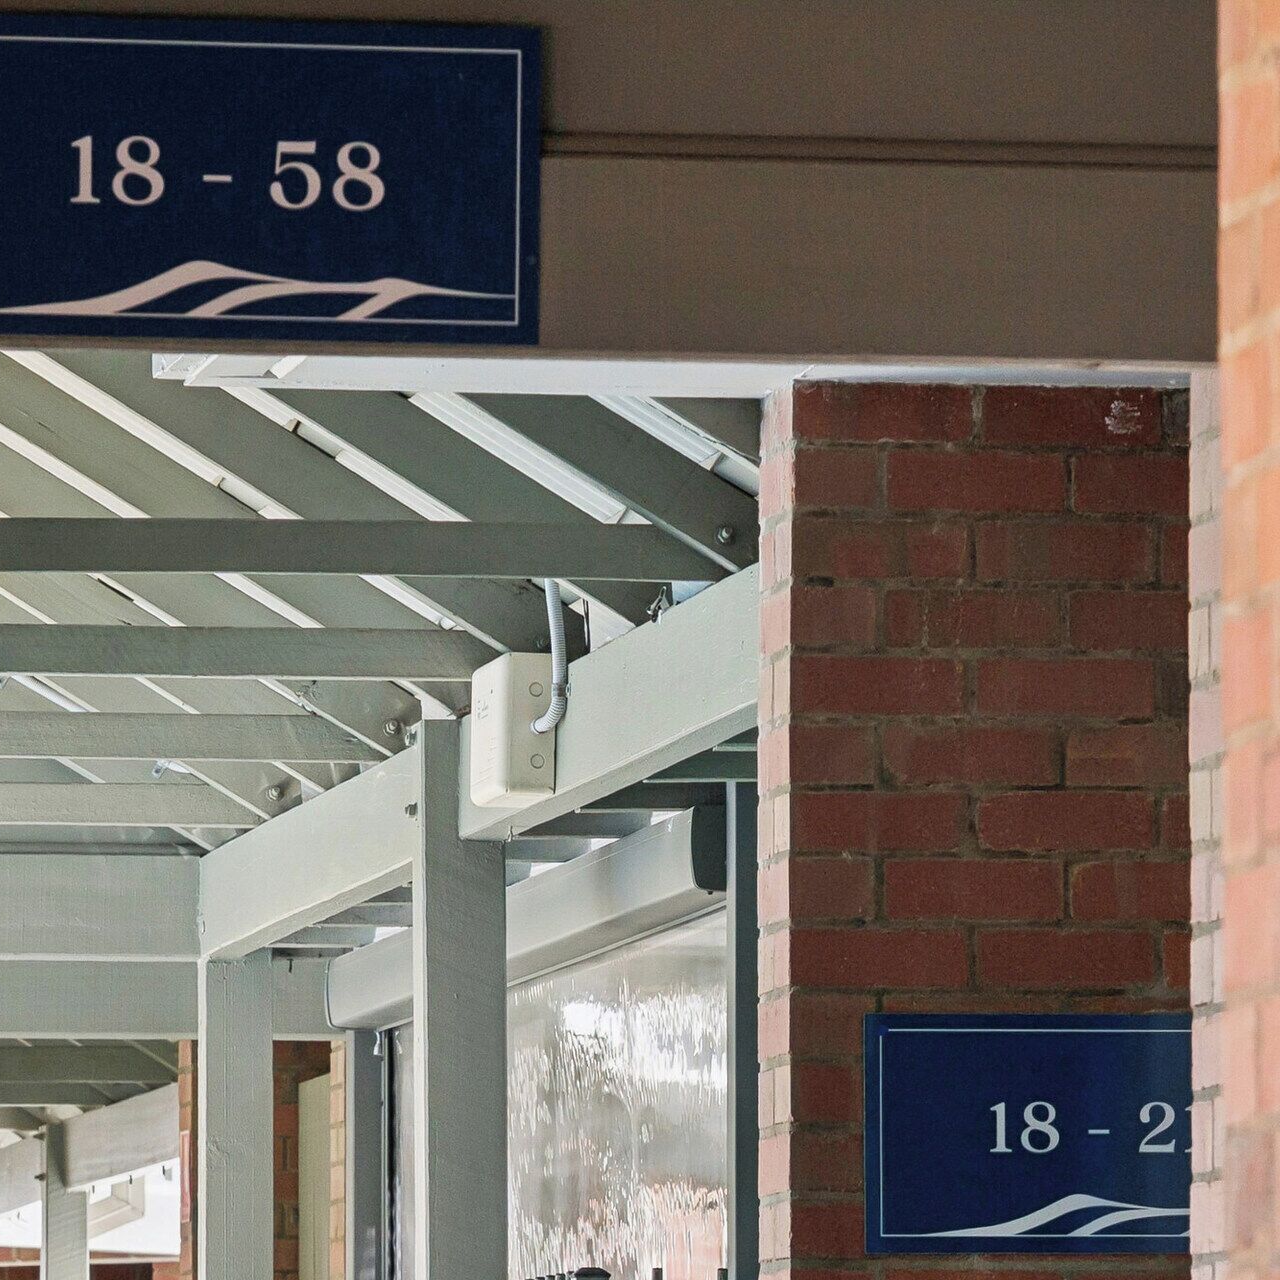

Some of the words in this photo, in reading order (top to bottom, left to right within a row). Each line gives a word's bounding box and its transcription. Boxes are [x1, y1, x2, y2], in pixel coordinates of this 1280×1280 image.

[70, 135, 165, 206] 18
[202, 174, 233, 183] -
[269, 140, 386, 212] 58
[989, 1101, 1060, 1154] 18
[1138, 1101, 1192, 1153] 2
